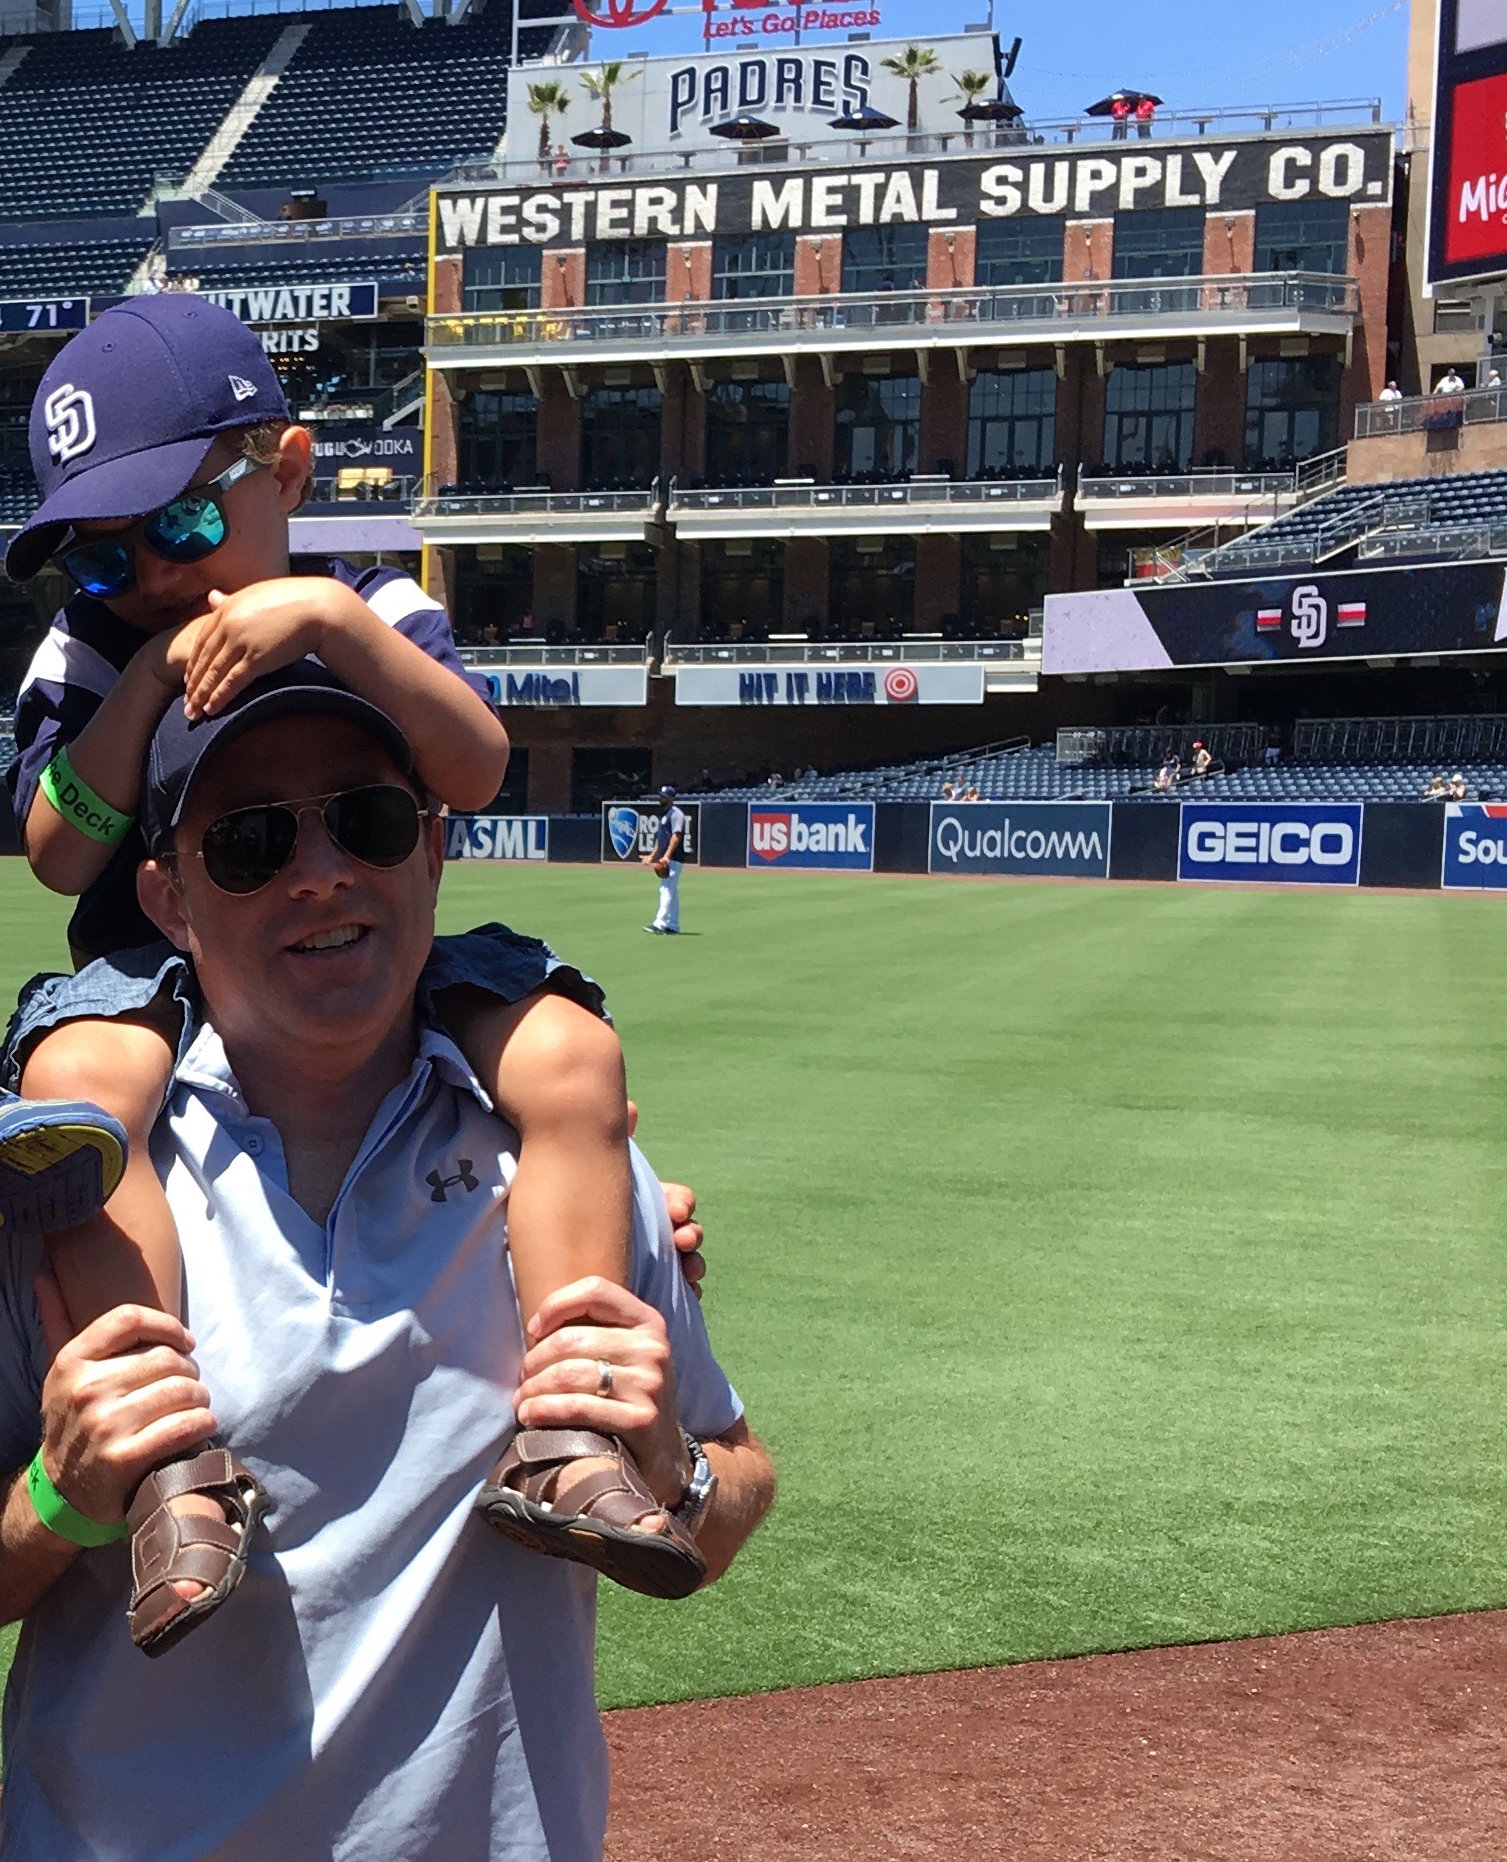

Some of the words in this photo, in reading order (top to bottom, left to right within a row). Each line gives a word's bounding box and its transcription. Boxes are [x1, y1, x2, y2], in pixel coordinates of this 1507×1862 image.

[703, 15, 754, 39] Let's
[761, 13, 796, 33] Go
[803, 9, 881, 30] Places
[669, 54, 871, 138] PADRES
[439, 183, 718, 247] WESTERN
[751, 168, 958, 232] METAL
[979, 149, 1238, 217] SUPPLY
[1268, 142, 1383, 200] CO.
[26, 301, 73, 328] 71°
[260, 329, 320, 353] RITS
[506, 671, 580, 701] Mitel
[739, 672, 778, 702] HIT
[786, 672, 809, 702] IT
[816, 672, 876, 702] HERE
[60, 783, 116, 836] Deck
[639, 815, 692, 833] ROT
[448, 820, 545, 859] ASML
[639, 834, 693, 852] LEE
[937, 817, 1103, 863] Qualcomm
[1188, 821, 1354, 865] GEICO
